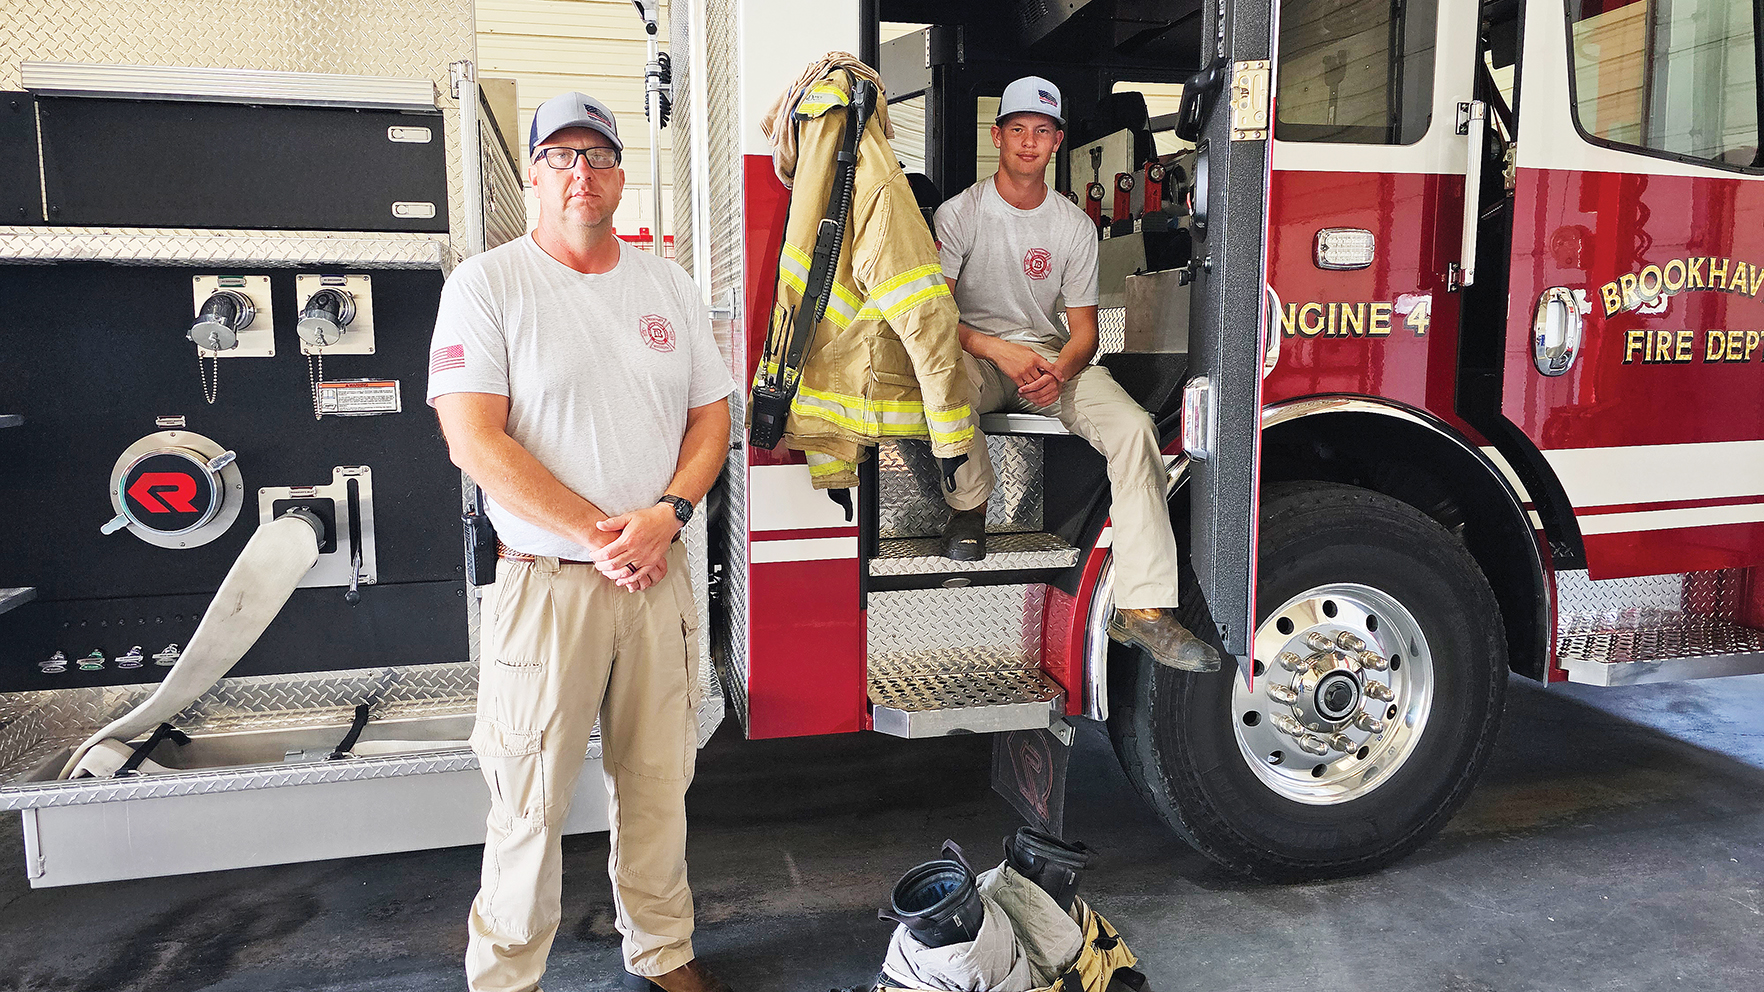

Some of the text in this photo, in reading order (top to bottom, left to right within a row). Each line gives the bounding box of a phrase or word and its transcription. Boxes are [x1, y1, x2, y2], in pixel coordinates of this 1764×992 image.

[1600, 256, 1764, 320] BROOKHAV
[1281, 301, 1430, 337] NGINE 4
[1622, 330, 1764, 364] FIRE DEP
